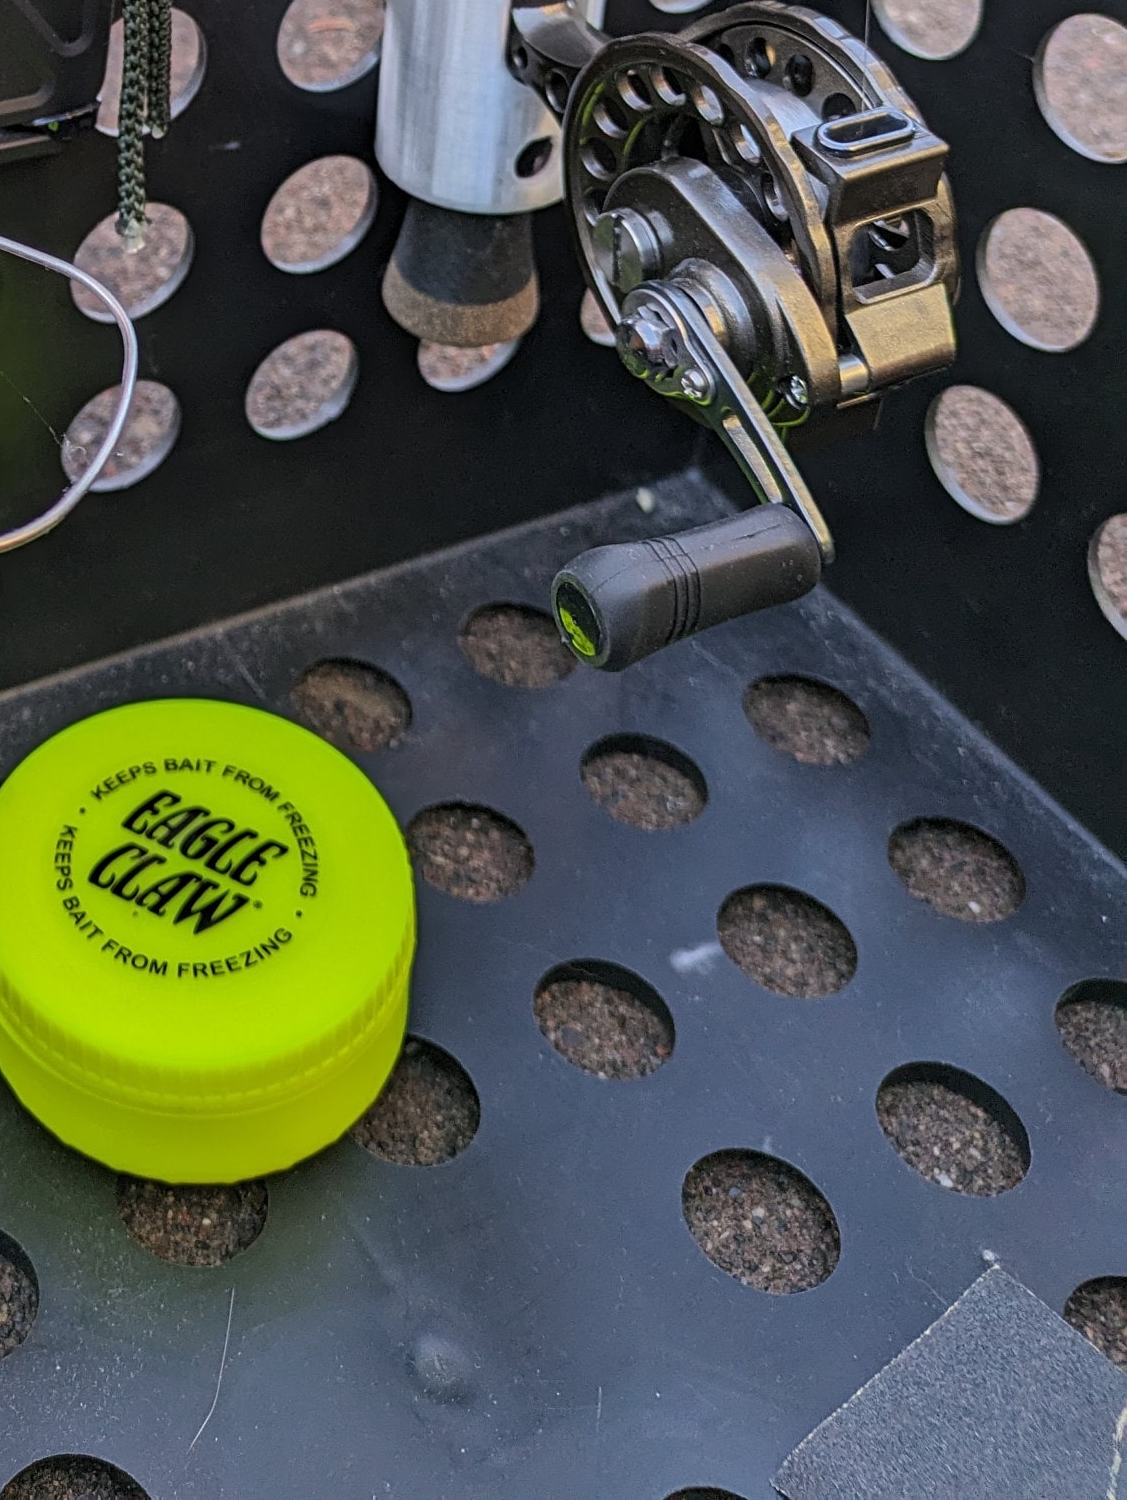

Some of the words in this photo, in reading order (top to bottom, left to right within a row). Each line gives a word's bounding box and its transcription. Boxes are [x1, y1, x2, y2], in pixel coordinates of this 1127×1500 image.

[54, 823, 78, 892] KEEPS
[90, 761, 158, 801] KEEPS
[164, 758, 217, 773] BAIT
[221, 764, 282, 802] FROM
[277, 801, 320, 898] FREEZING
[121, 789, 289, 887] EAGLE
[62, 895, 104, 940] BAIT
[87, 841, 251, 937] CLAW
[101, 938, 168, 976] FROM
[177, 927, 293, 978] FREEZING
